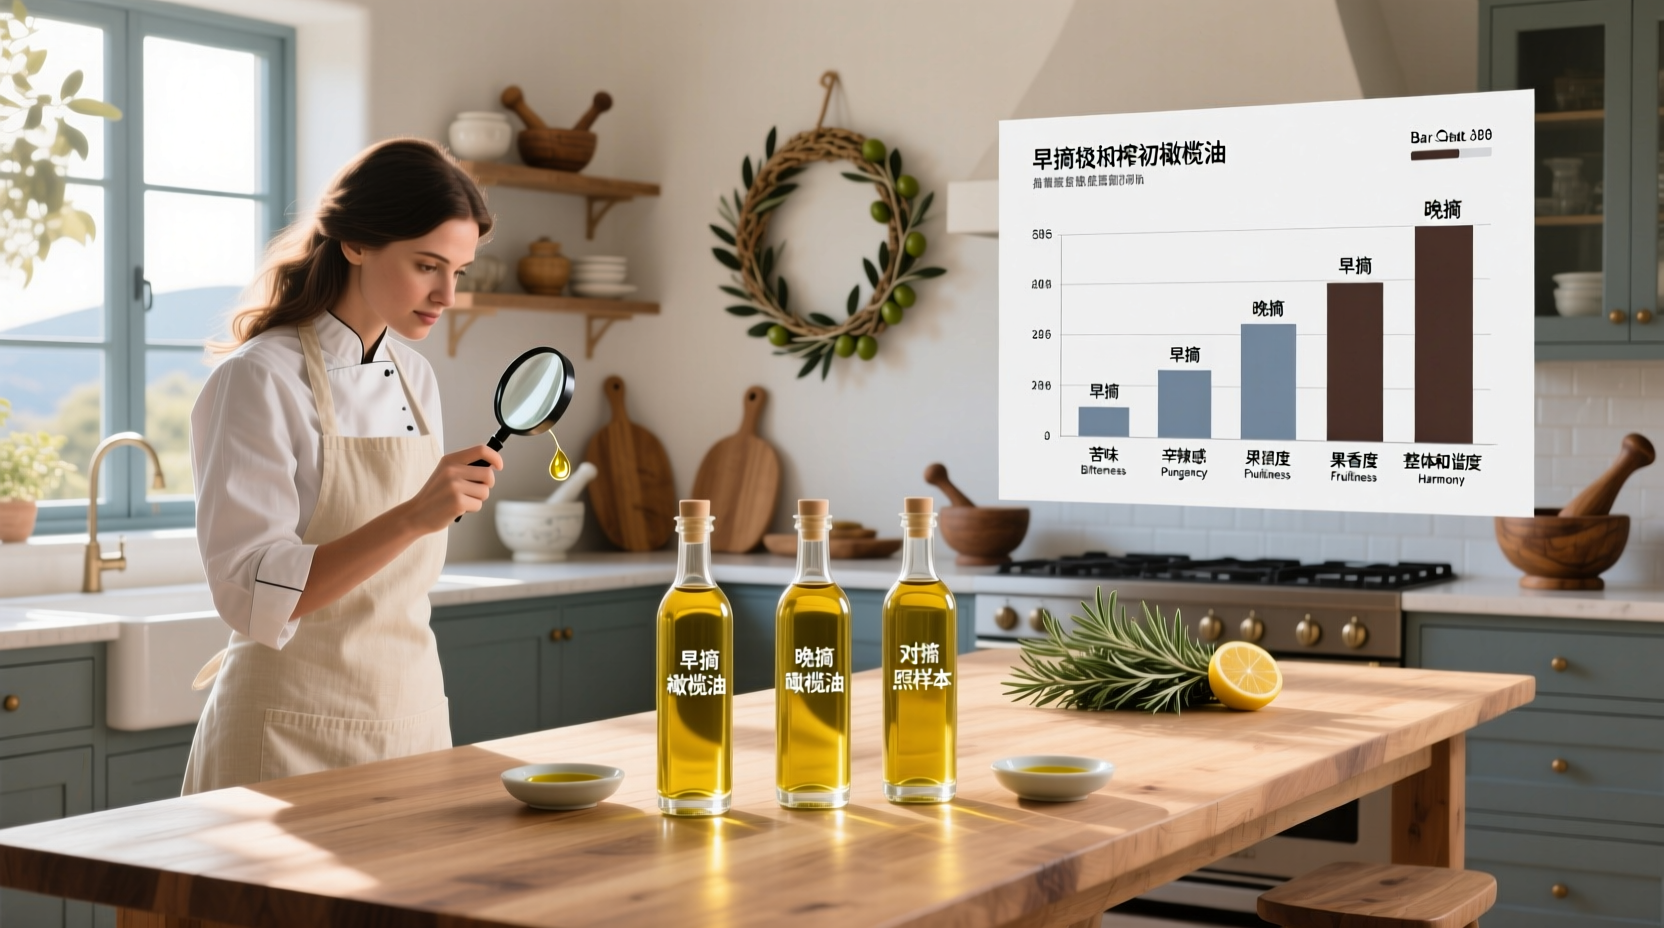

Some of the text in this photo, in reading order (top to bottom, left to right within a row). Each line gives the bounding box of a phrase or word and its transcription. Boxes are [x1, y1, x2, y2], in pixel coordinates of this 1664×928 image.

[1410, 131, 1433, 144] Bar
[1338, 255, 1373, 276] 早摘
[1169, 345, 1202, 365] 早摘
[1089, 382, 1120, 401] 早摘
[1043, 430, 1052, 442] 0
[1088, 446, 1119, 463] 苦味
[1161, 446, 1207, 465] 辛辣感
[1330, 451, 1380, 470] 果香度
[1402, 451, 1484, 472] 整体和谐度
[1417, 473, 1466, 488] Harmony
[680, 649, 720, 671] 早摘
[794, 646, 835, 669] 晚摘
